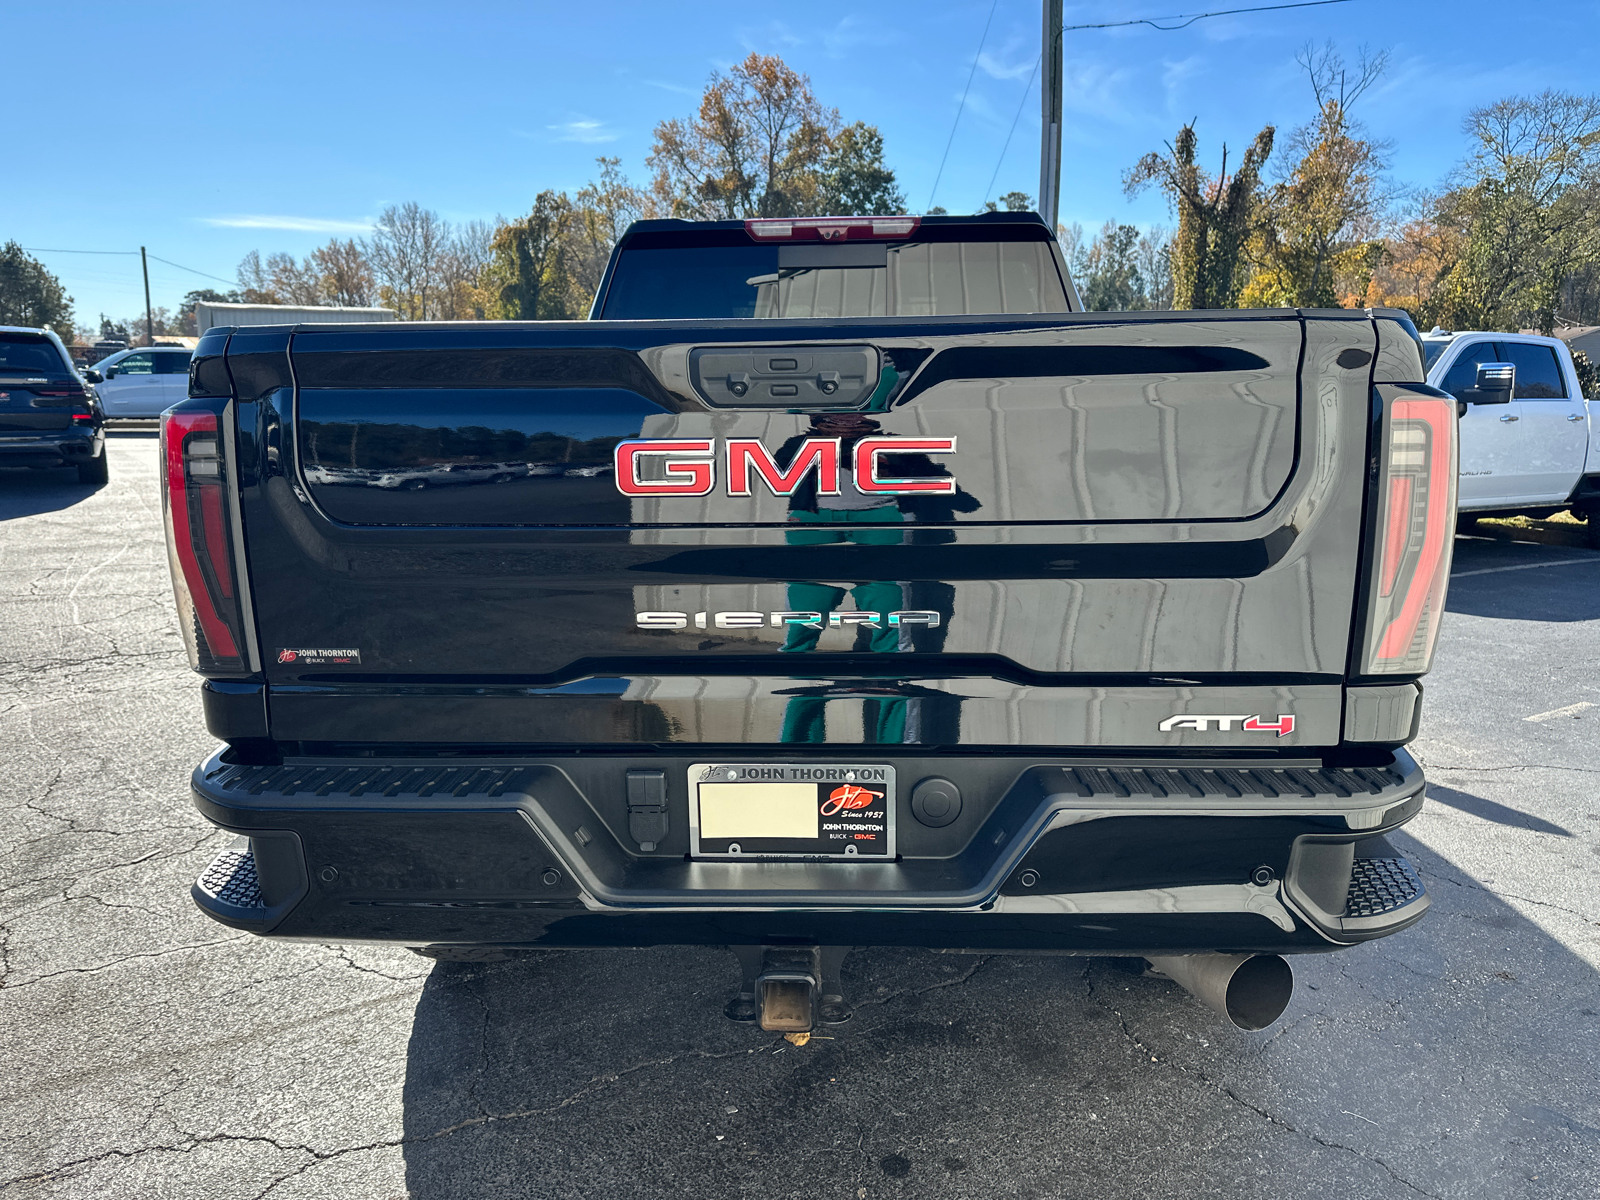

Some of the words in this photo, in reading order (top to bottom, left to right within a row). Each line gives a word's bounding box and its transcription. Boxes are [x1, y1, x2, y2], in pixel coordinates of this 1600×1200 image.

[614, 437, 957, 498] GMC
[635, 610, 941, 630] SIERRA
[299, 649, 318, 657] JOHN
[318, 649, 358, 657] THORNTON
[1158, 714, 1296, 738] AT4
[739, 768, 785, 780] JOHN
[790, 768, 885, 780] THORNTON
[841, 810, 862, 818] Since
[864, 811, 884, 819] 1957
